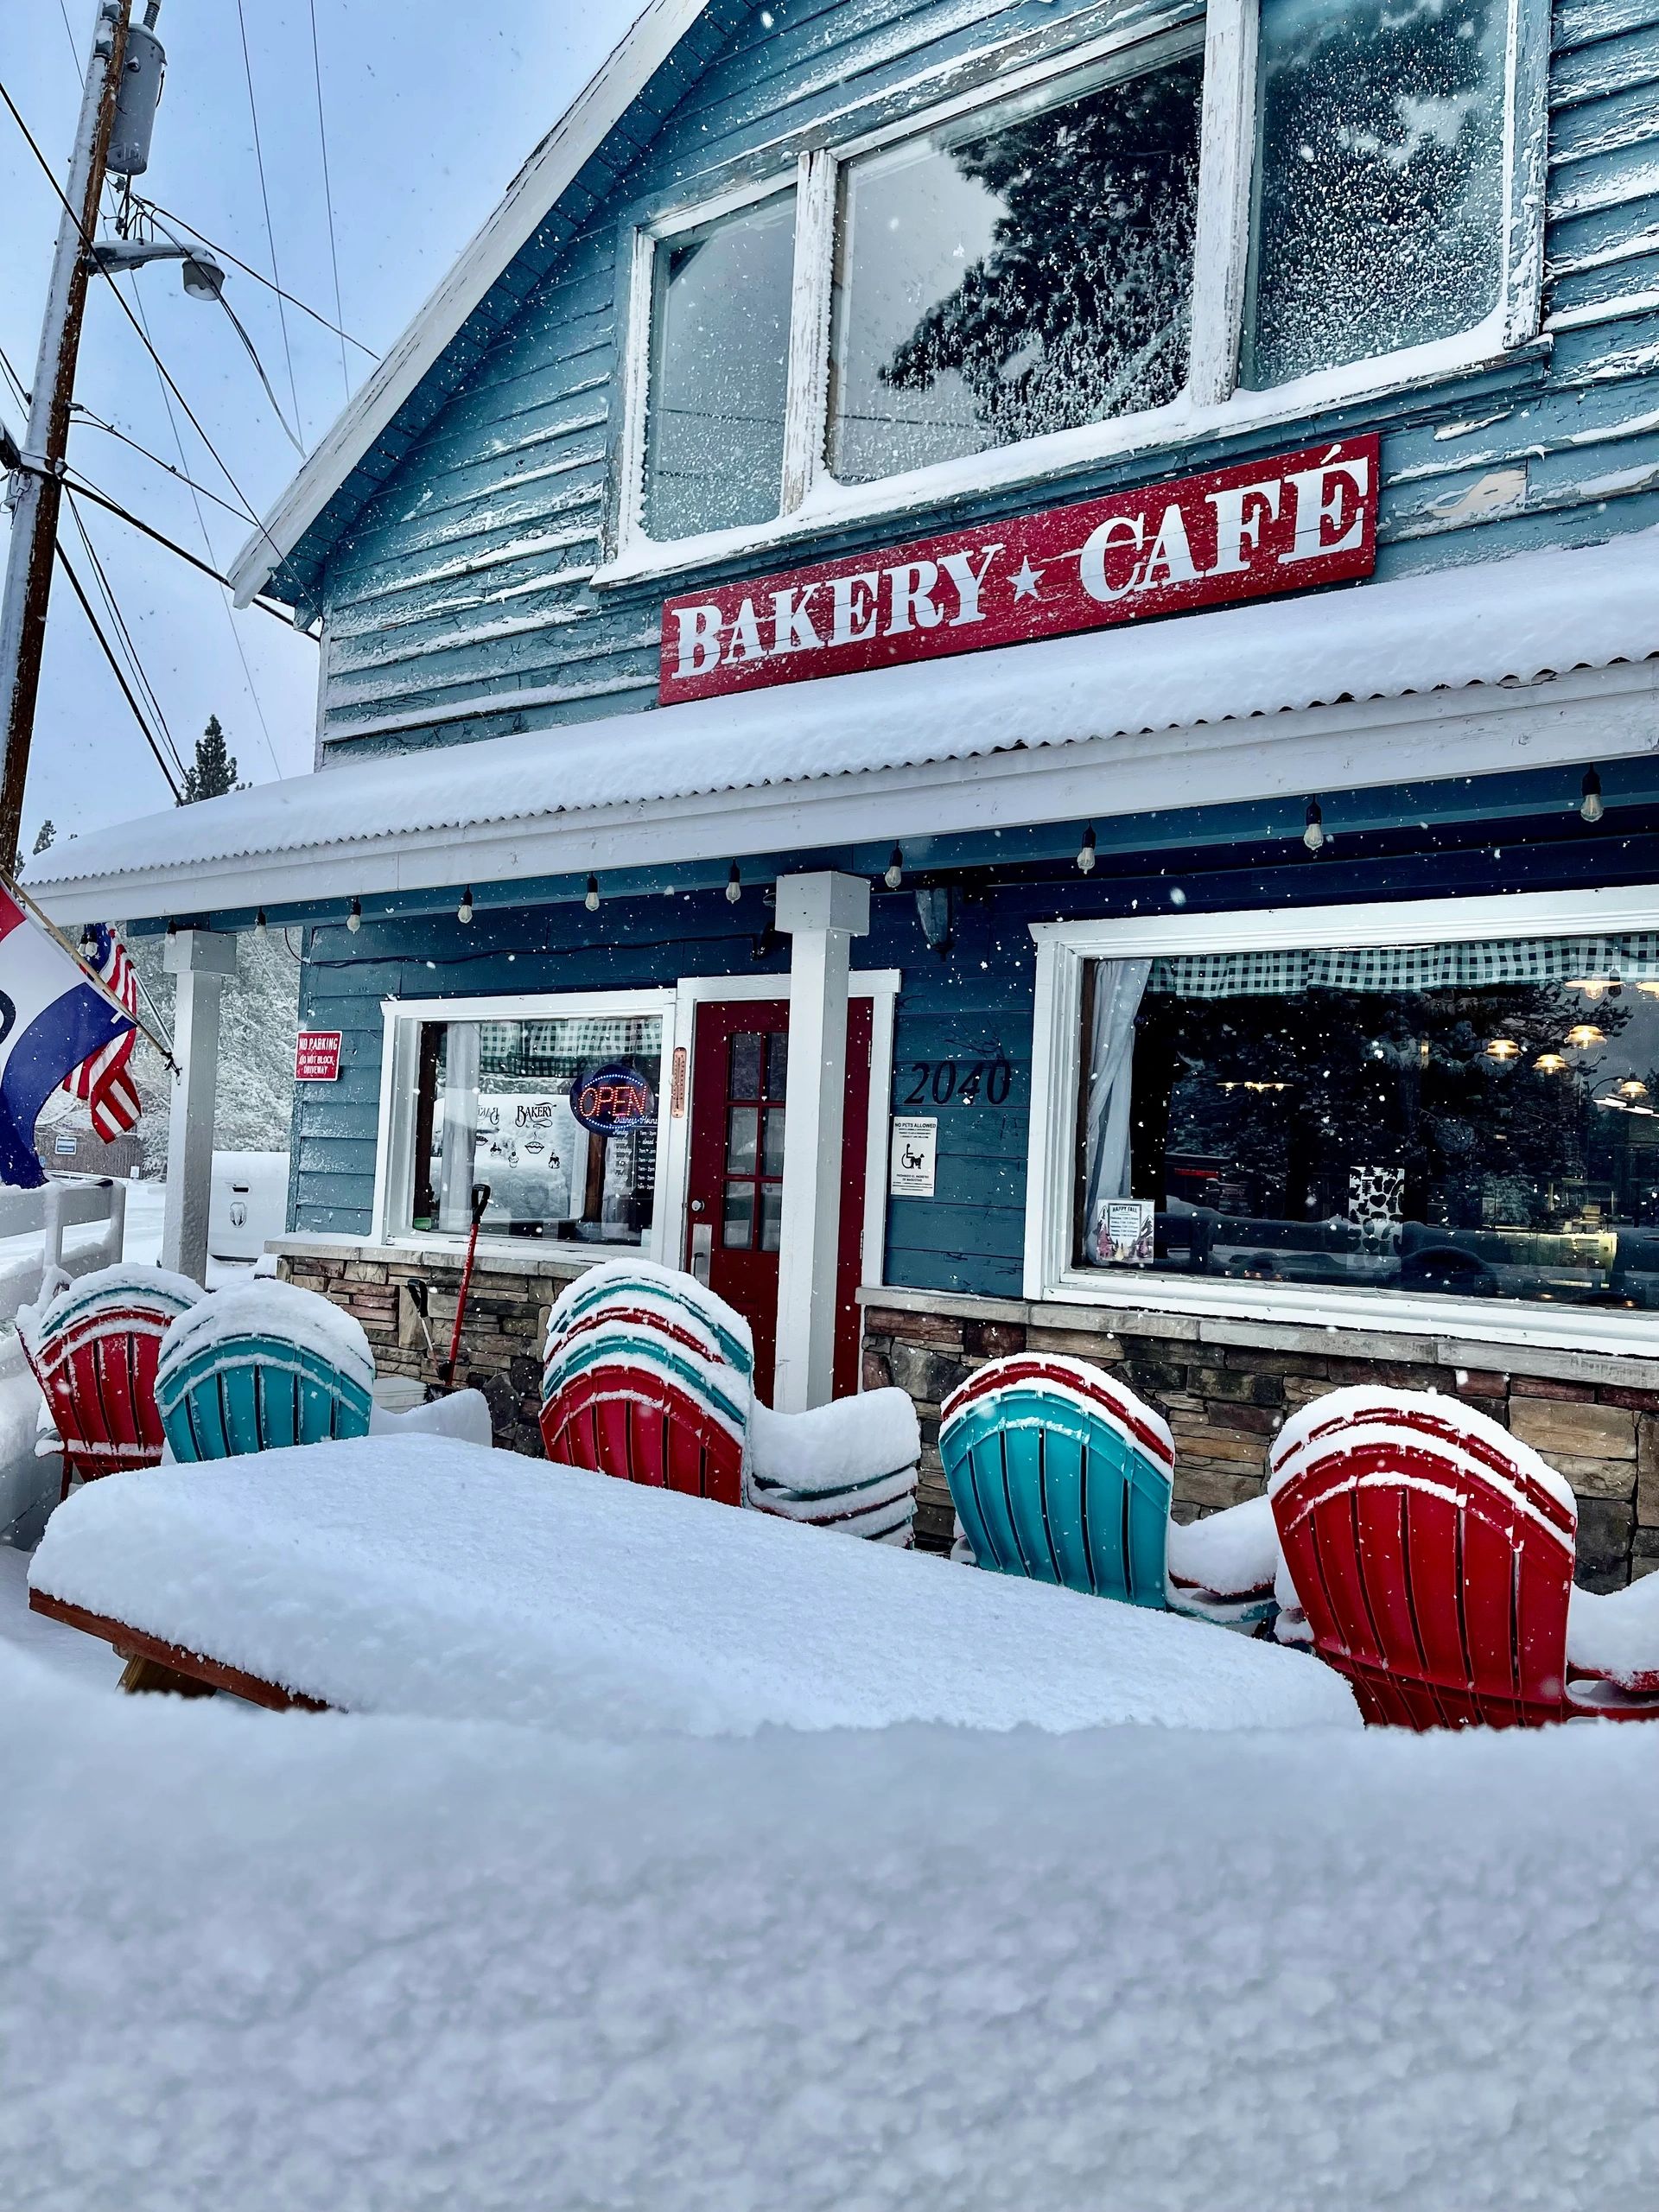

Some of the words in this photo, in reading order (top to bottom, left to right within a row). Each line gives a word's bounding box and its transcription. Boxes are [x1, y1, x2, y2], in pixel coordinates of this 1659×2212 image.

[670, 542, 1004, 679] BAKERY
[1079, 444, 1368, 602] CAFÉ
[299, 1038, 308, 1050] NO
[308, 1038, 338, 1050] PARKING
[303, 1065, 328, 1074] DRIVEWAY
[307, 1055, 317, 1064] NOT
[317, 1055, 334, 1065] BLOCK
[903, 1060, 1012, 1105] 2040
[579, 1086, 647, 1116] OPEN
[515, 1103, 555, 1127] BAKERY
